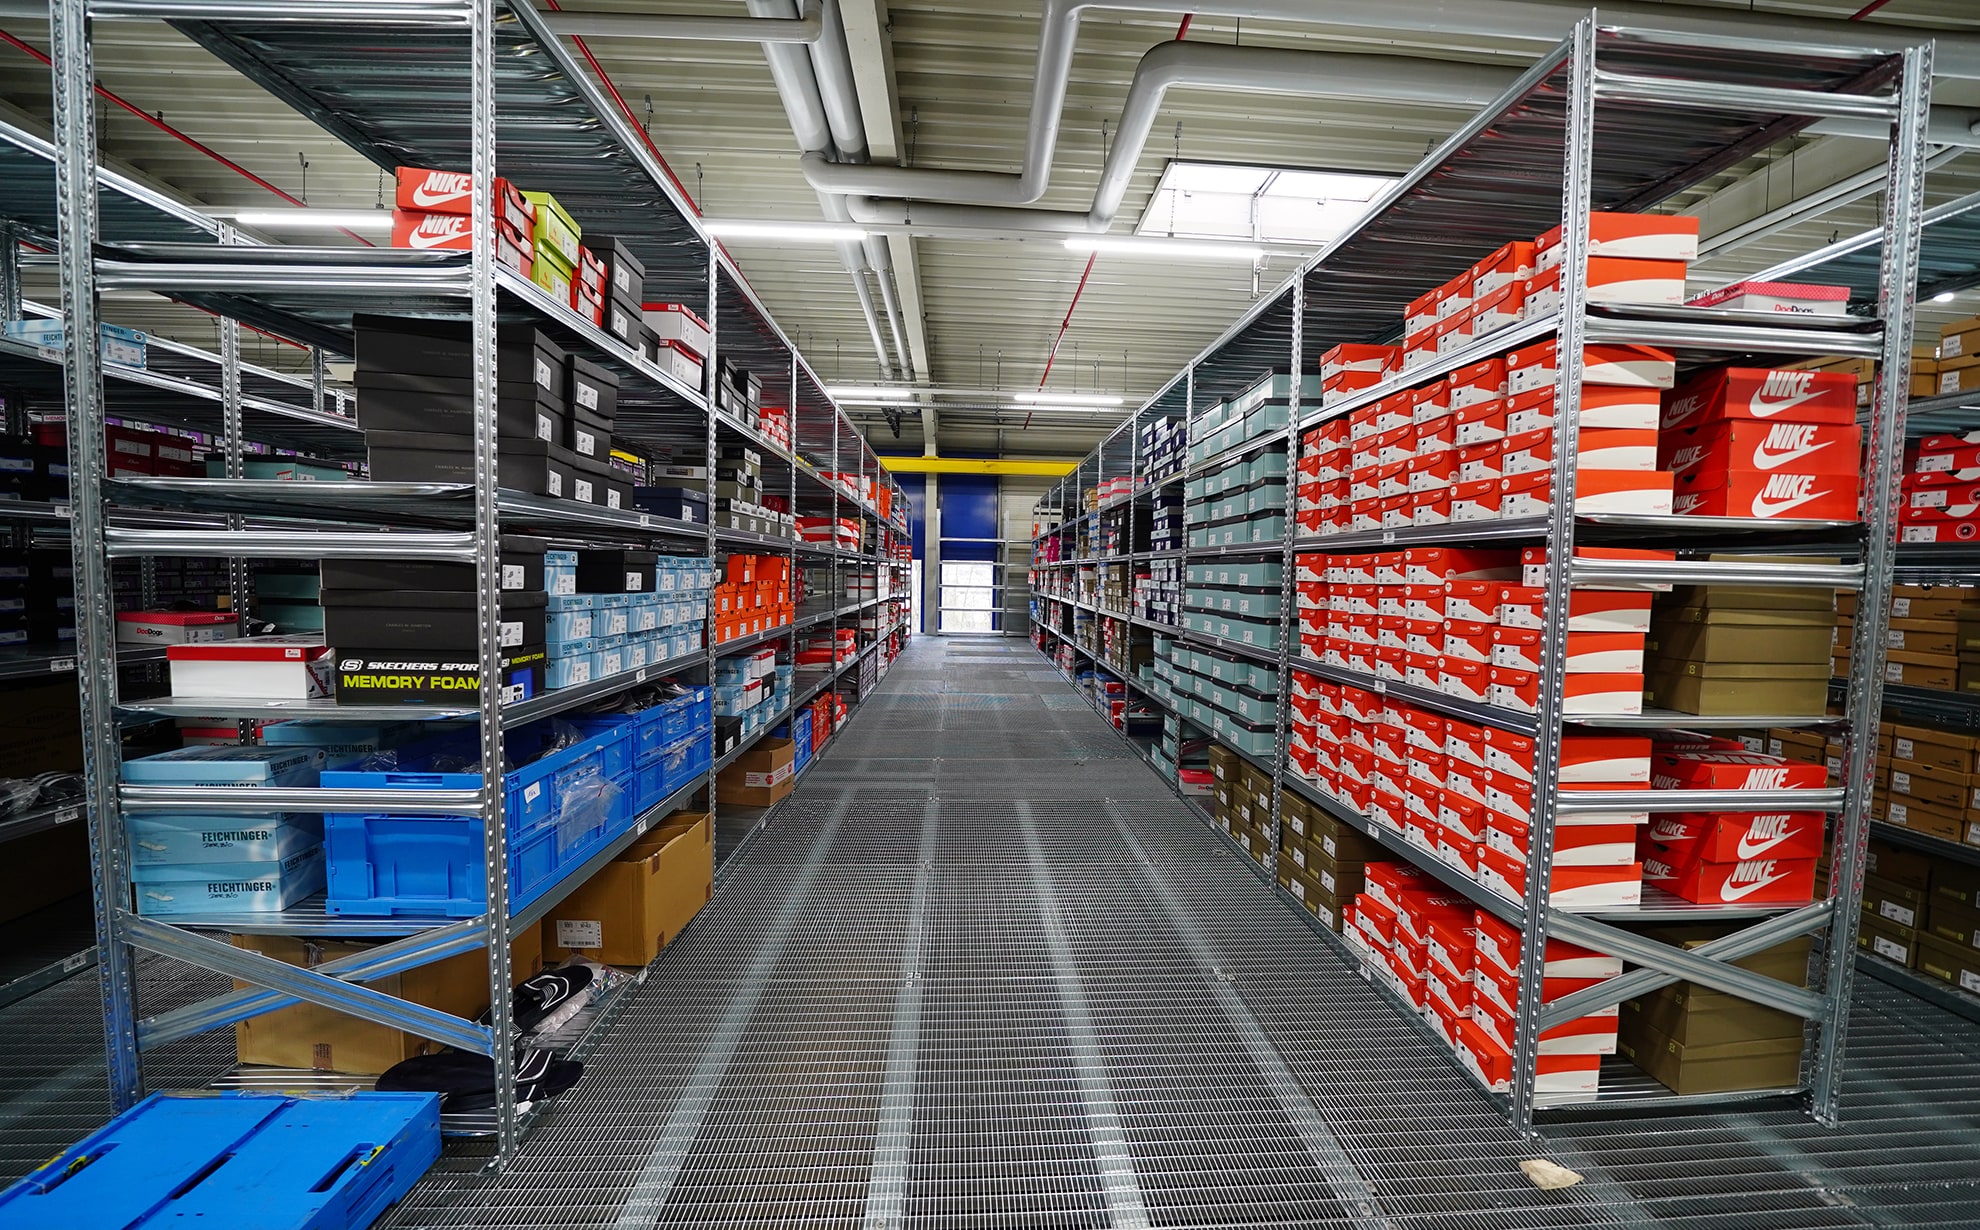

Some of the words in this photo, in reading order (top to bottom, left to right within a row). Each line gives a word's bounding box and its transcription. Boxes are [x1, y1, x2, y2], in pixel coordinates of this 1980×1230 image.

[424, 171, 472, 193] NIKE
[419, 215, 467, 235] NIKE
[1761, 371, 1815, 398] NIKE
[1669, 395, 1699, 416] NIKE
[1764, 424, 1818, 450] NIKE
[1672, 446, 1702, 465] NIKE
[1763, 474, 1816, 499] NIKE
[1674, 493, 1700, 509] NIKE
[367, 661, 439, 671] SKECHERS
[440, 662, 480, 671] SPOR
[511, 656, 531, 665] MEMORY
[532, 653, 544, 662] FOAM
[343, 675, 425, 689] MEMORY
[430, 676, 481, 690] FOAM
[270, 754, 309, 772] FEICHTINGER
[1652, 774, 1681, 789] NIKE
[1745, 768, 1789, 790] NIKE
[202, 830, 269, 842] FEICHTINGER
[1657, 819, 1688, 836] NIKE
[1748, 815, 1791, 839] NIKE
[1644, 858, 1671, 878] NIKE
[1731, 860, 1778, 882] NIKE
[207, 881, 273, 893] FEICHTINGER
